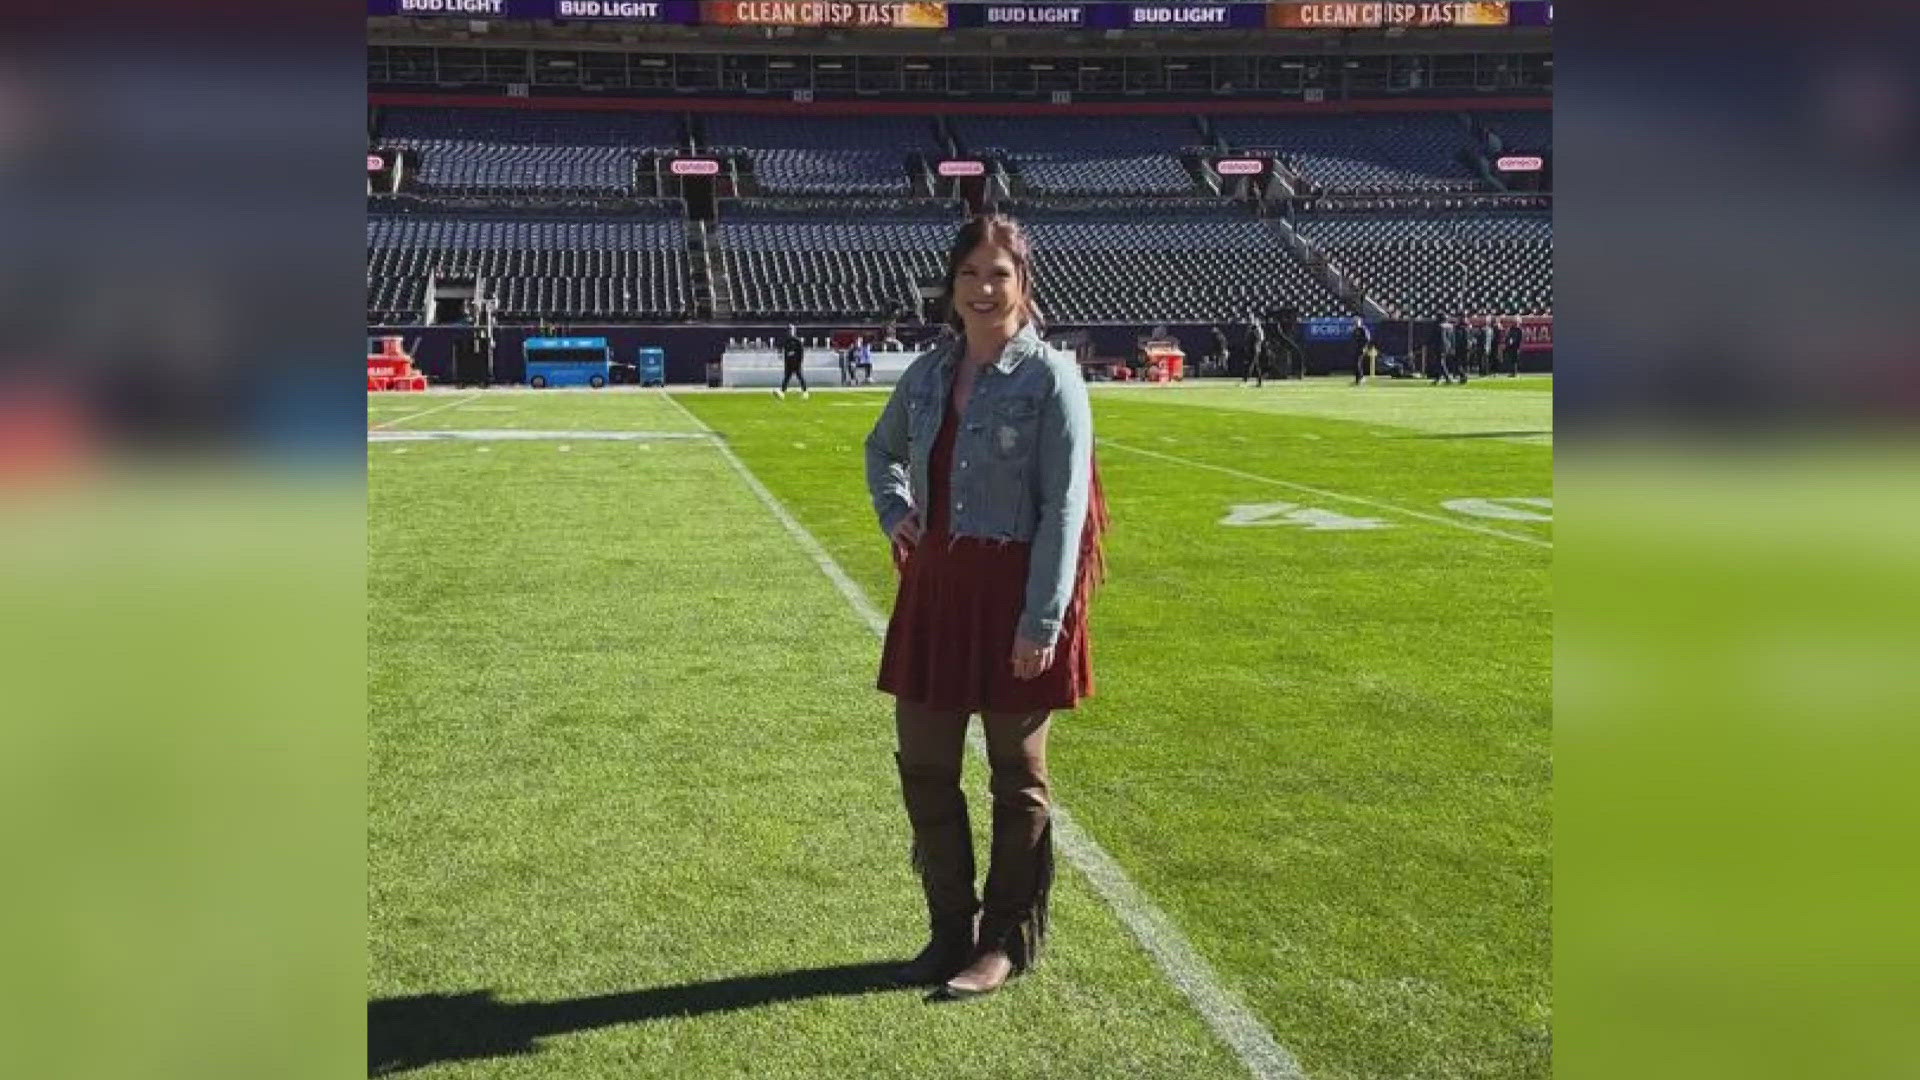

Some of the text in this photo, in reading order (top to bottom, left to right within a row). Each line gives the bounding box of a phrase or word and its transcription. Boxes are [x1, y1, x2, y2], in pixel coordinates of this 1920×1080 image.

[402, 0, 504, 13] BUD LIGHT
[560, 1, 660, 18] BUD LIGHT
[736, 3, 912, 24] CLEAN CRISP TASTE
[987, 7, 1082, 22] BUD LIGHT
[1134, 7, 1227, 22] BUD LIGHT
[1300, 4, 1475, 23] CLEAN CRISP TASTE
